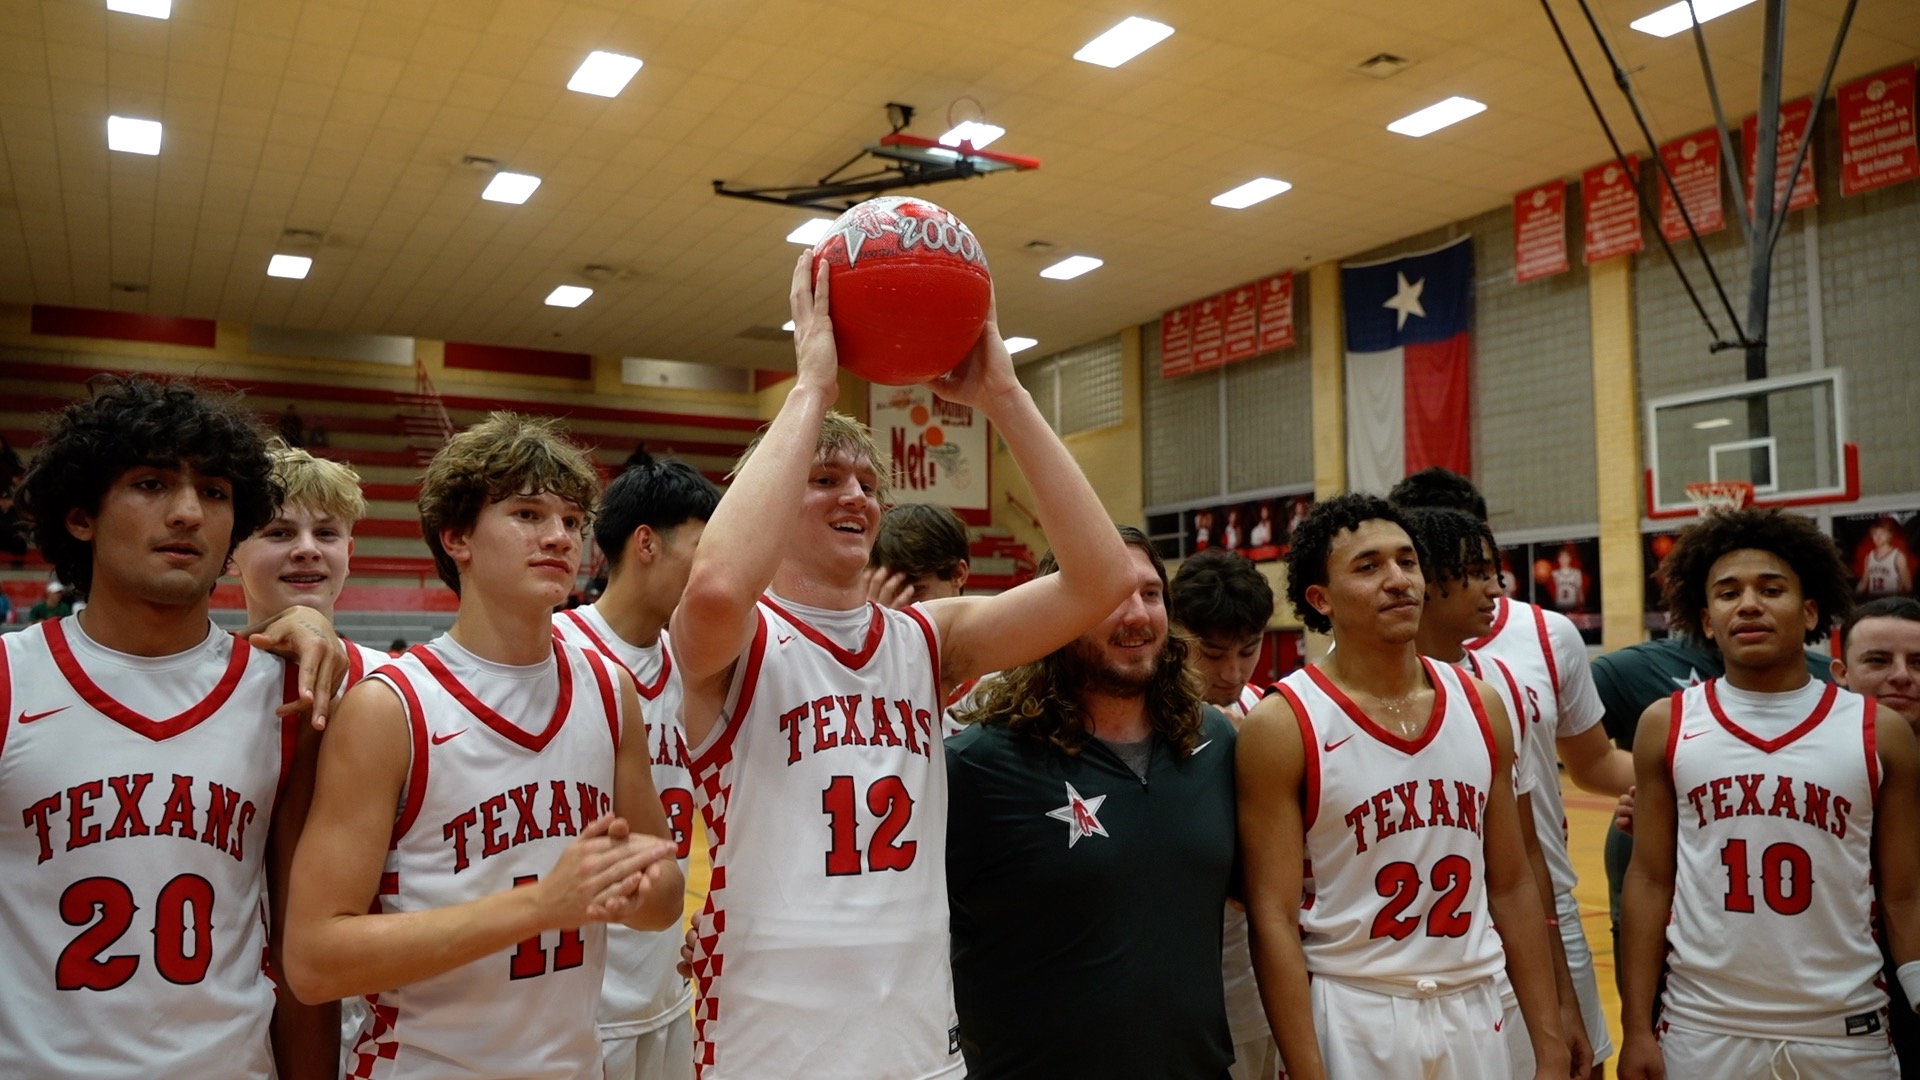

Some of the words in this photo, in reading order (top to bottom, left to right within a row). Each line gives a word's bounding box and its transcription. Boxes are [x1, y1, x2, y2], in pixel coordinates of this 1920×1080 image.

[899, 216, 976, 261] 2000
[891, 426, 935, 490] Net!
[22, 772, 256, 866] TEXANS
[822, 775, 917, 877] 12
[1687, 773, 1852, 840] TEXANS
[1369, 854, 1473, 941] 22
[1720, 838, 1815, 916] 10
[55, 872, 216, 992] 20
